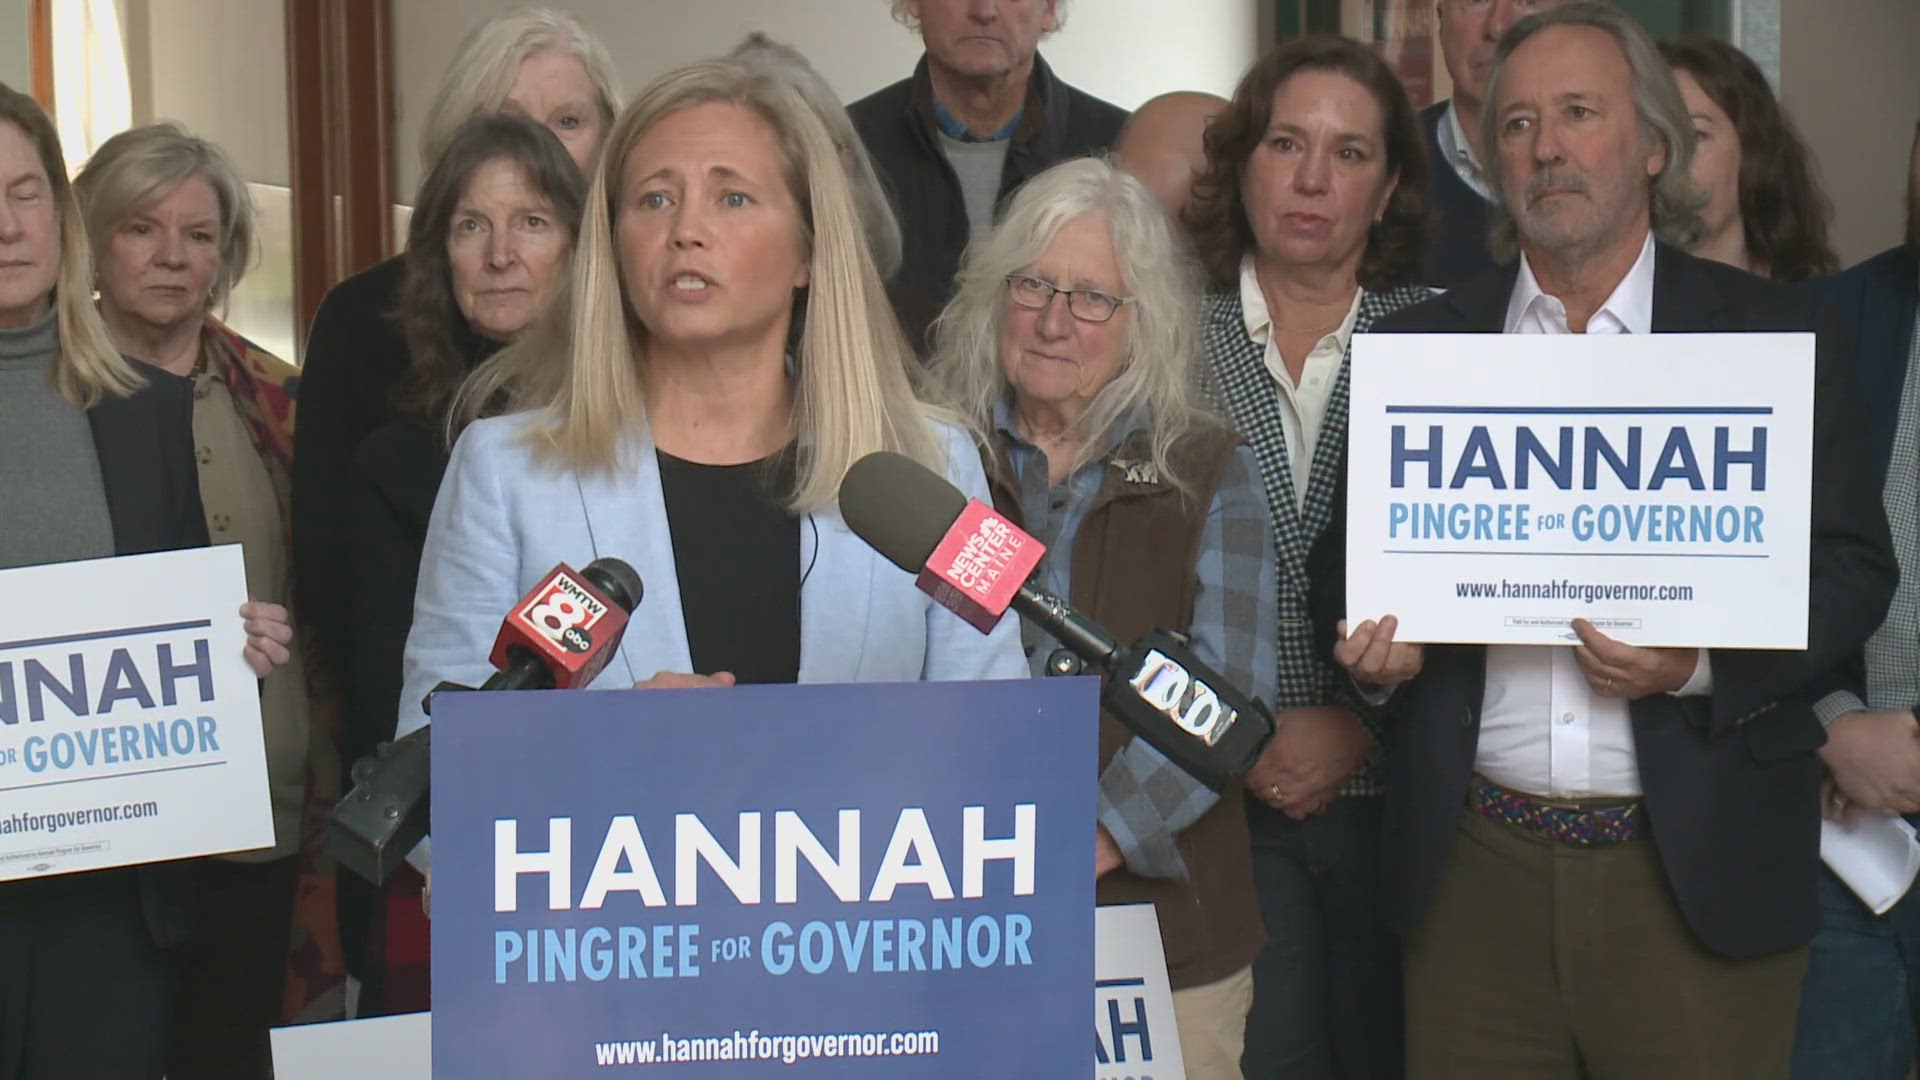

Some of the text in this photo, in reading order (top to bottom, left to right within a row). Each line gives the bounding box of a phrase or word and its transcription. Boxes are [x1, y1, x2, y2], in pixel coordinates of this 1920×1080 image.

[1390, 425, 1768, 491] HANNAH
[1389, 502, 1765, 543] PINGREE FOR GOVERNOR
[946, 533, 985, 580] NEWS
[959, 522, 1012, 588] CENTER
[975, 535, 1023, 595] MAINE
[531, 592, 586, 641] 8
[557, 577, 603, 615] WMTW
[1456, 579, 1693, 604] www.hannahforgovernor.com
[0, 638, 215, 726] NAH
[23, 715, 220, 773] GOVERNOR
[0, 800, 158, 834] ahforgovernor.com
[494, 804, 1037, 912] HANNAH
[495, 913, 1033, 984] PINGREE FOR GOVERNOR
[595, 1030, 939, 1066] www.hannahforgovernor.com
[1095, 997, 1153, 1064] H
